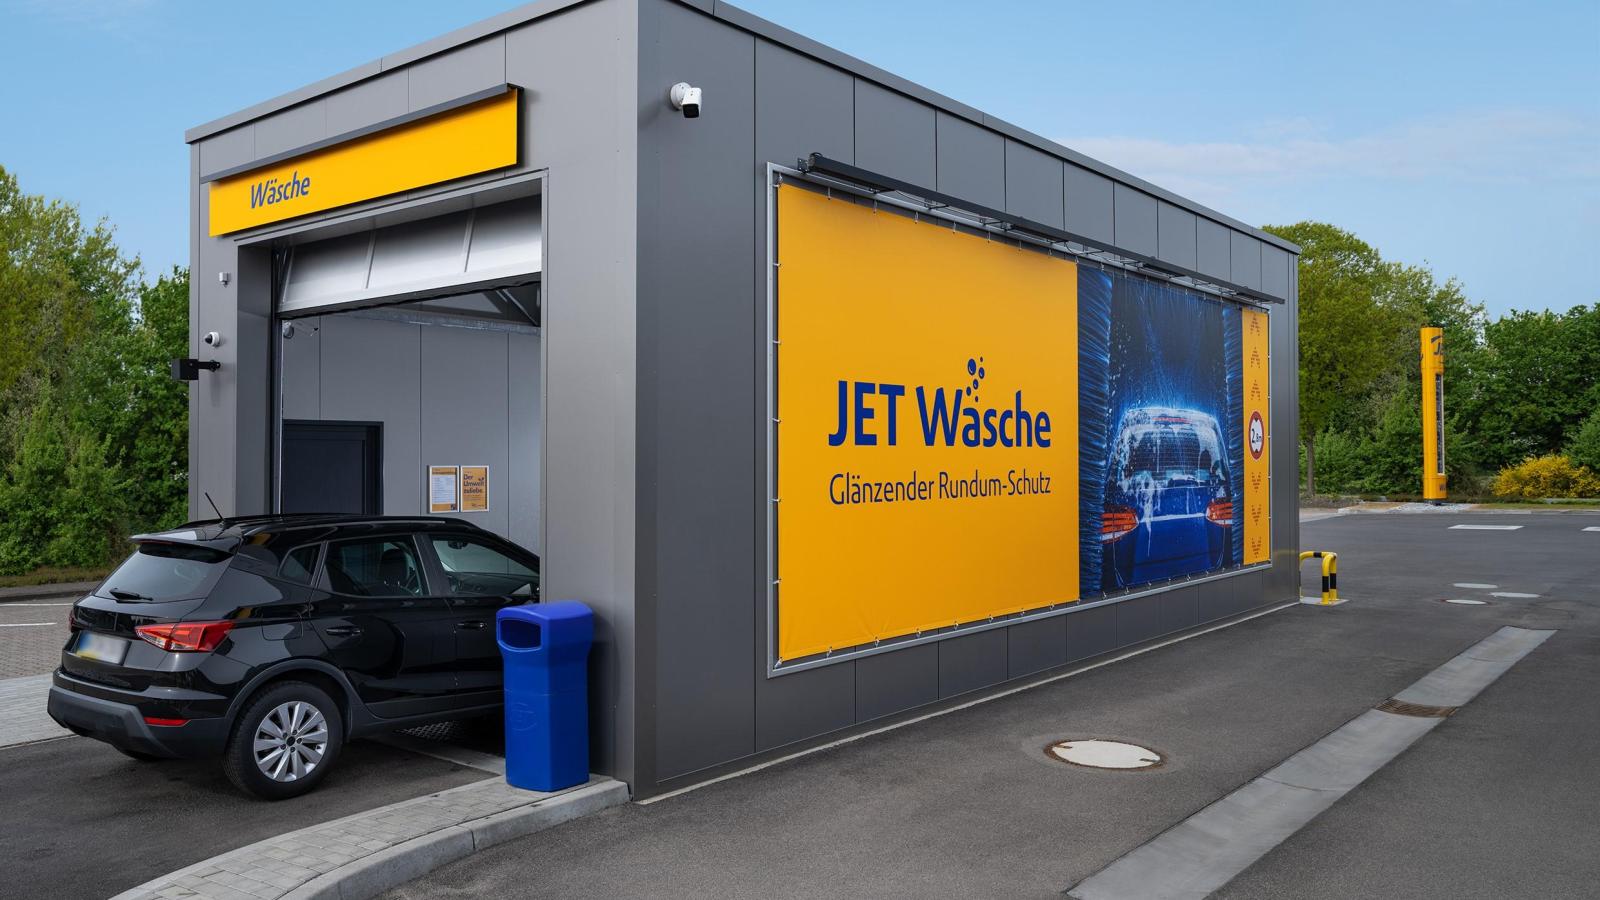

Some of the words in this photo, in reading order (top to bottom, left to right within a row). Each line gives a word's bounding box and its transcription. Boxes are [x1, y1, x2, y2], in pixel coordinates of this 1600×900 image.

[251, 170, 310, 209] Wäsche
[828, 380, 905, 446] JET
[829, 470, 934, 505] Glänzender
[939, 468, 1051, 499] Rundum-Schutz
